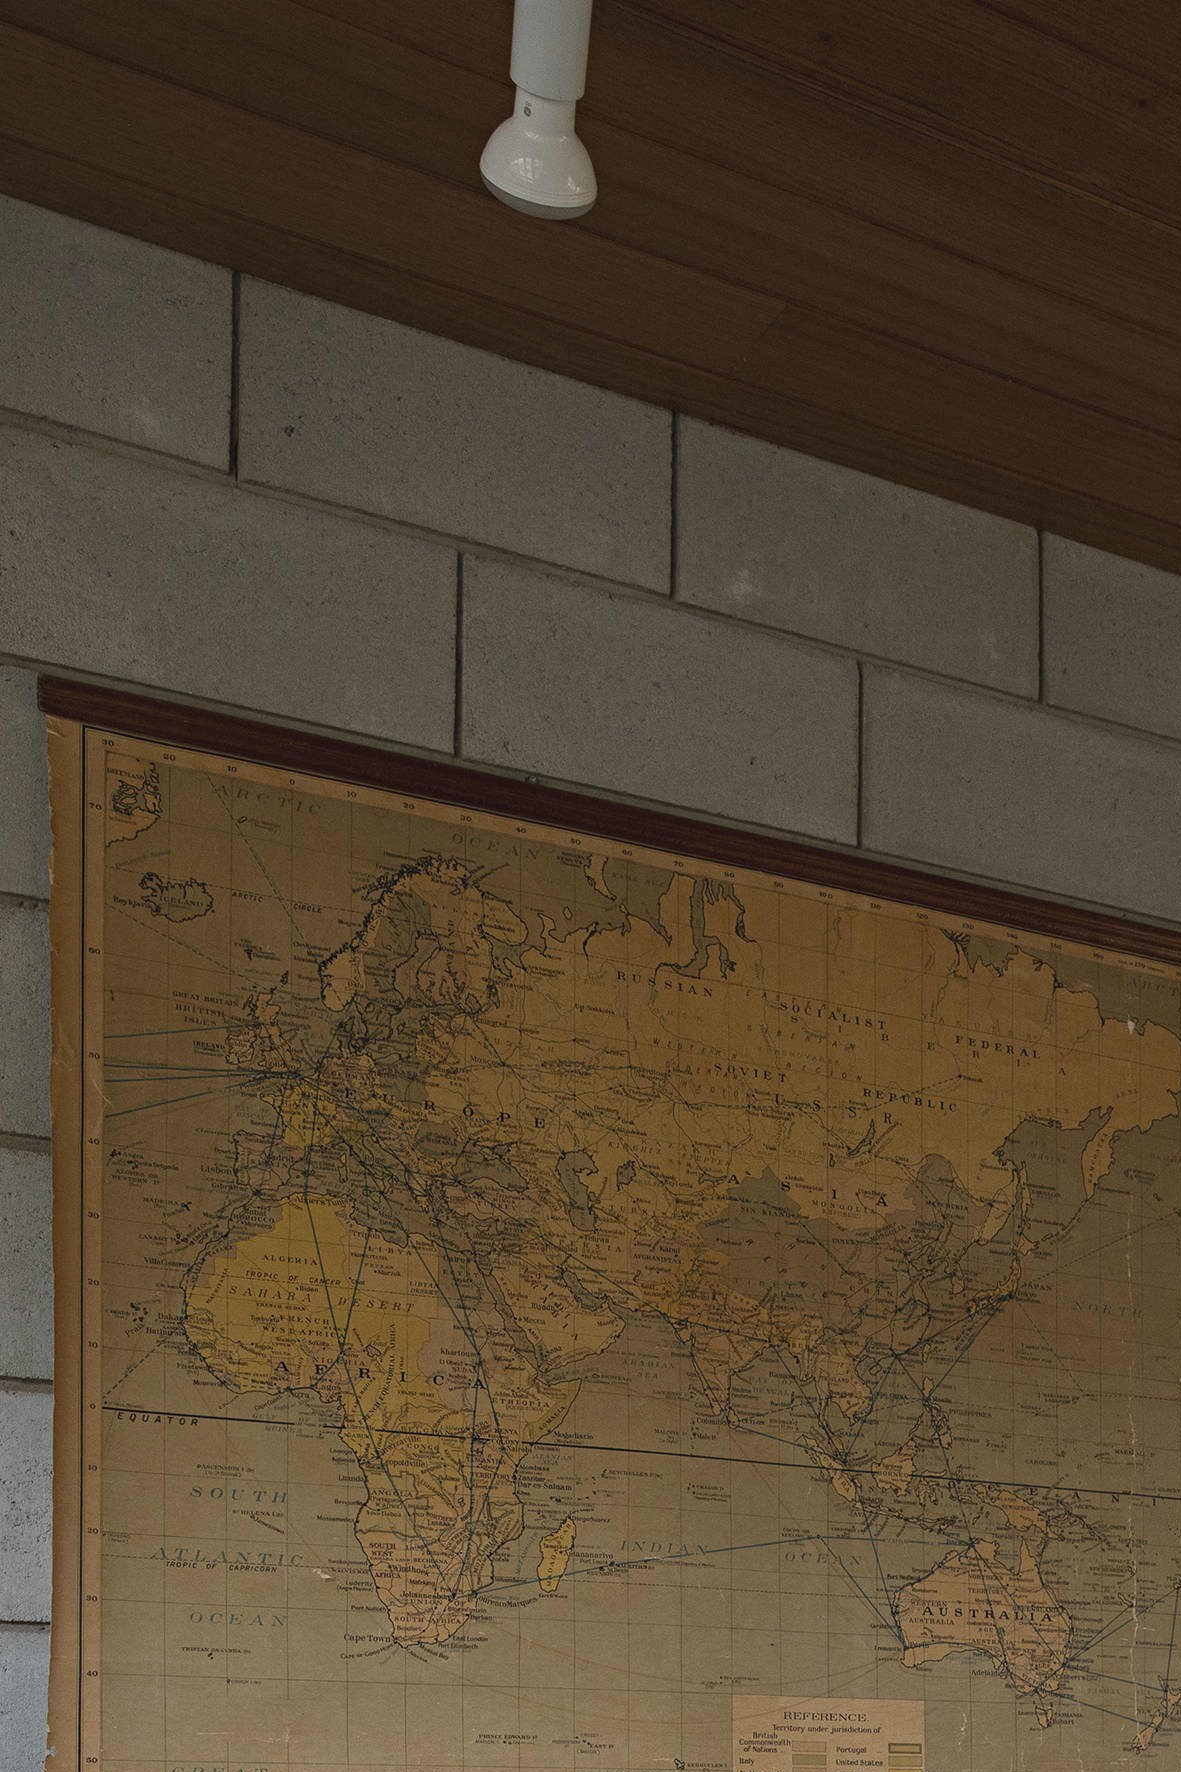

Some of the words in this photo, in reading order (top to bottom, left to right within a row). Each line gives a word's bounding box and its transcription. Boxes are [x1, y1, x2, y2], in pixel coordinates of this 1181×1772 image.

[617, 971, 713, 998] RUSSIAN
[955, 1035, 1041, 1060] FEDERAL
[713, 1063, 787, 1083] SOVIET
[229, 1285, 312, 1303] SAHARA
[117, 1412, 199, 1427] EQUATOR
[189, 1486, 288, 1505] SOUTH
[151, 1547, 304, 1566] ATLANTIC
[189, 1612, 288, 1627] OCEAN
[922, 1607, 1053, 1623] AUSTRALIA
[86, 1670, 99, 1678] 40
[783, 1711, 870, 1722] REFERENCE.
[873, 1726, 882, 1734] of
[836, 1746, 867, 1755] Portugal
